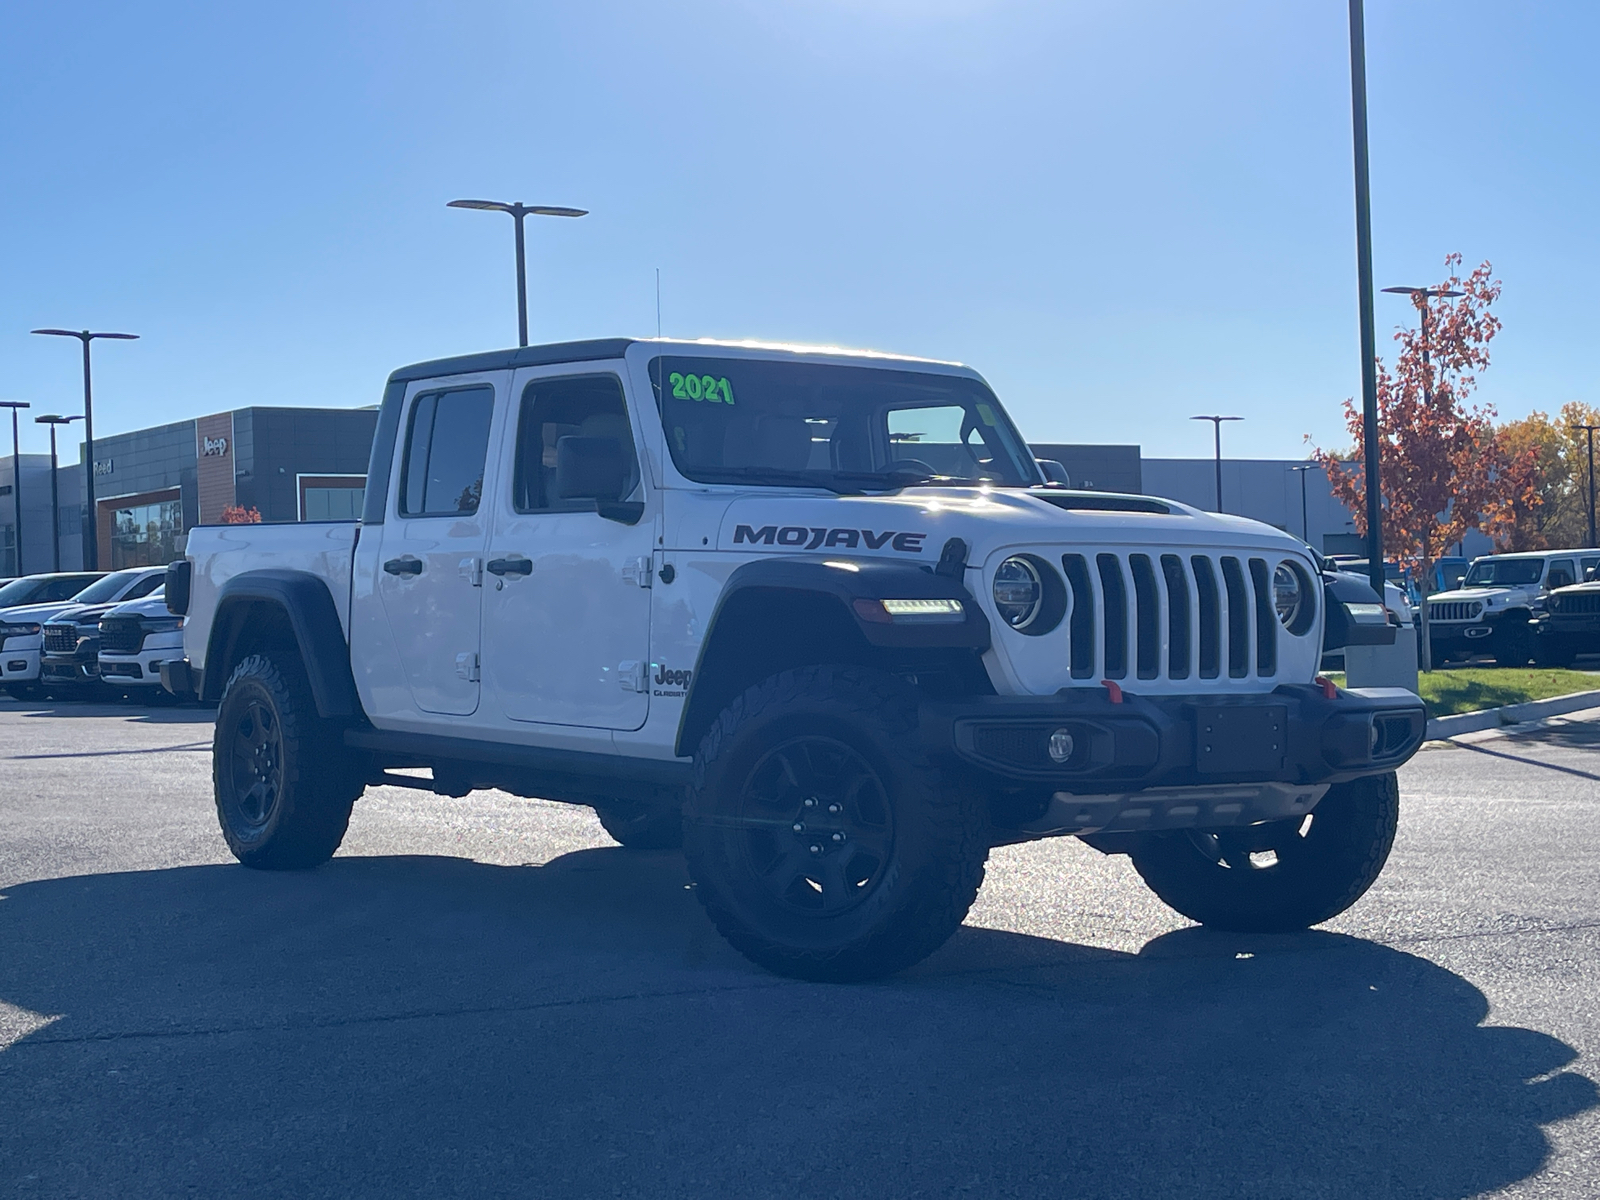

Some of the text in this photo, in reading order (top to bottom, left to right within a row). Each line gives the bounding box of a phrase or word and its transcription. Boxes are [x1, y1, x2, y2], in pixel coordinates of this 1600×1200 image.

[670, 372, 735, 405] 2021
[203, 436, 227, 456] Jeep
[733, 524, 927, 552] MOJAVE
[655, 664, 692, 690] Jeep
